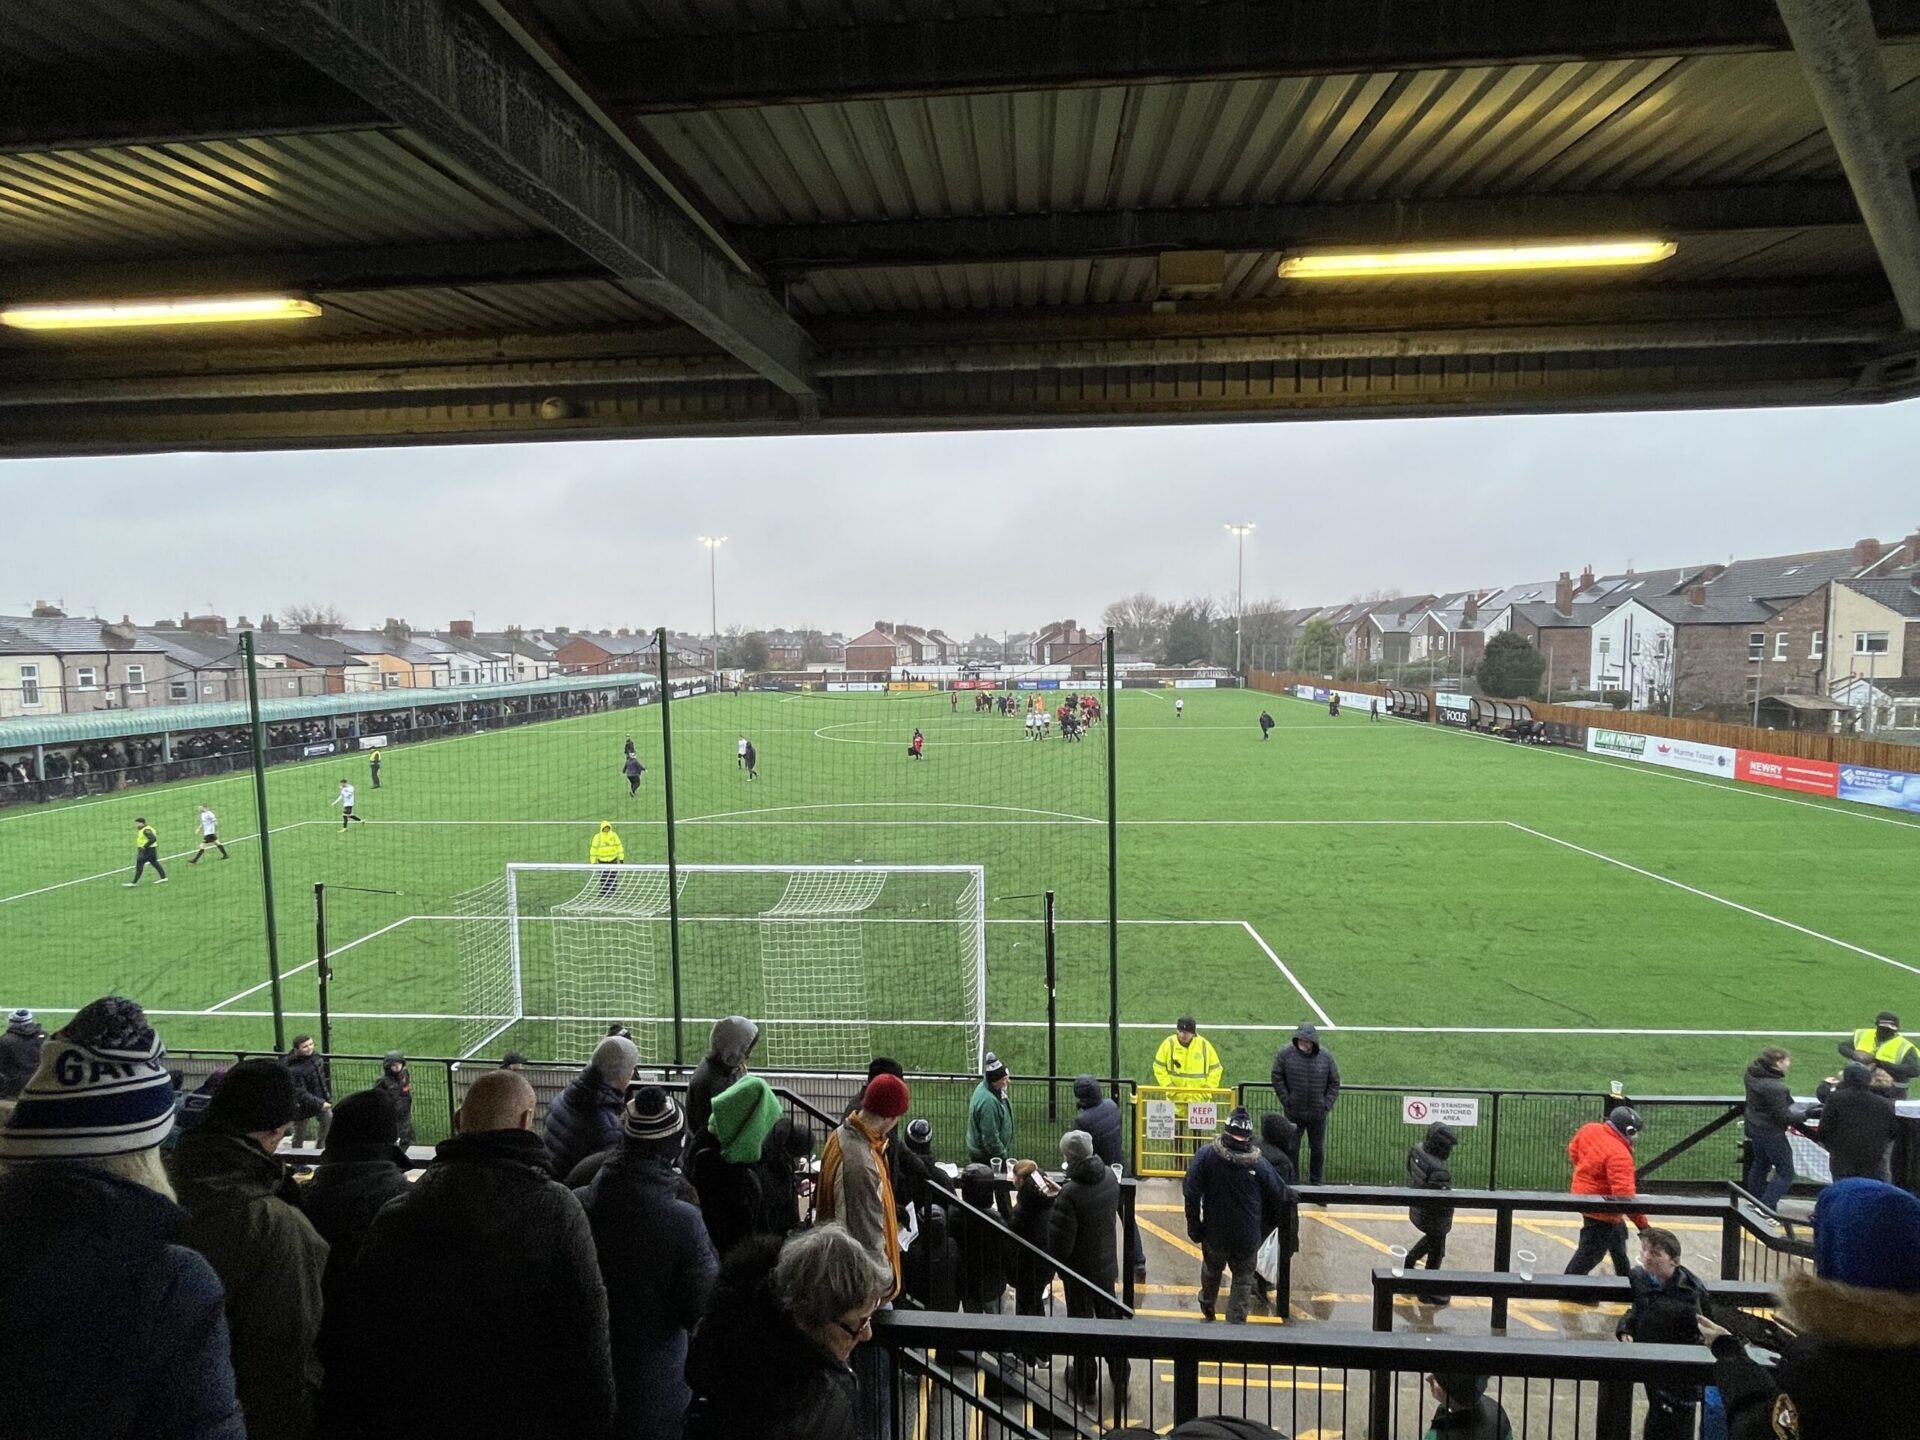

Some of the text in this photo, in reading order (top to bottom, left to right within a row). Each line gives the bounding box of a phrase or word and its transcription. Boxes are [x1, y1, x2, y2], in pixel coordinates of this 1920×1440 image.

[1446, 710, 1467, 723] FOCUS
[1596, 731, 1615, 745] LAWN
[1615, 733, 1645, 750] MOWING
[1750, 760, 1783, 774] NEWRY
[1192, 1107, 1213, 1115] KEEP
[1190, 1116, 1215, 1125] CLEAR
